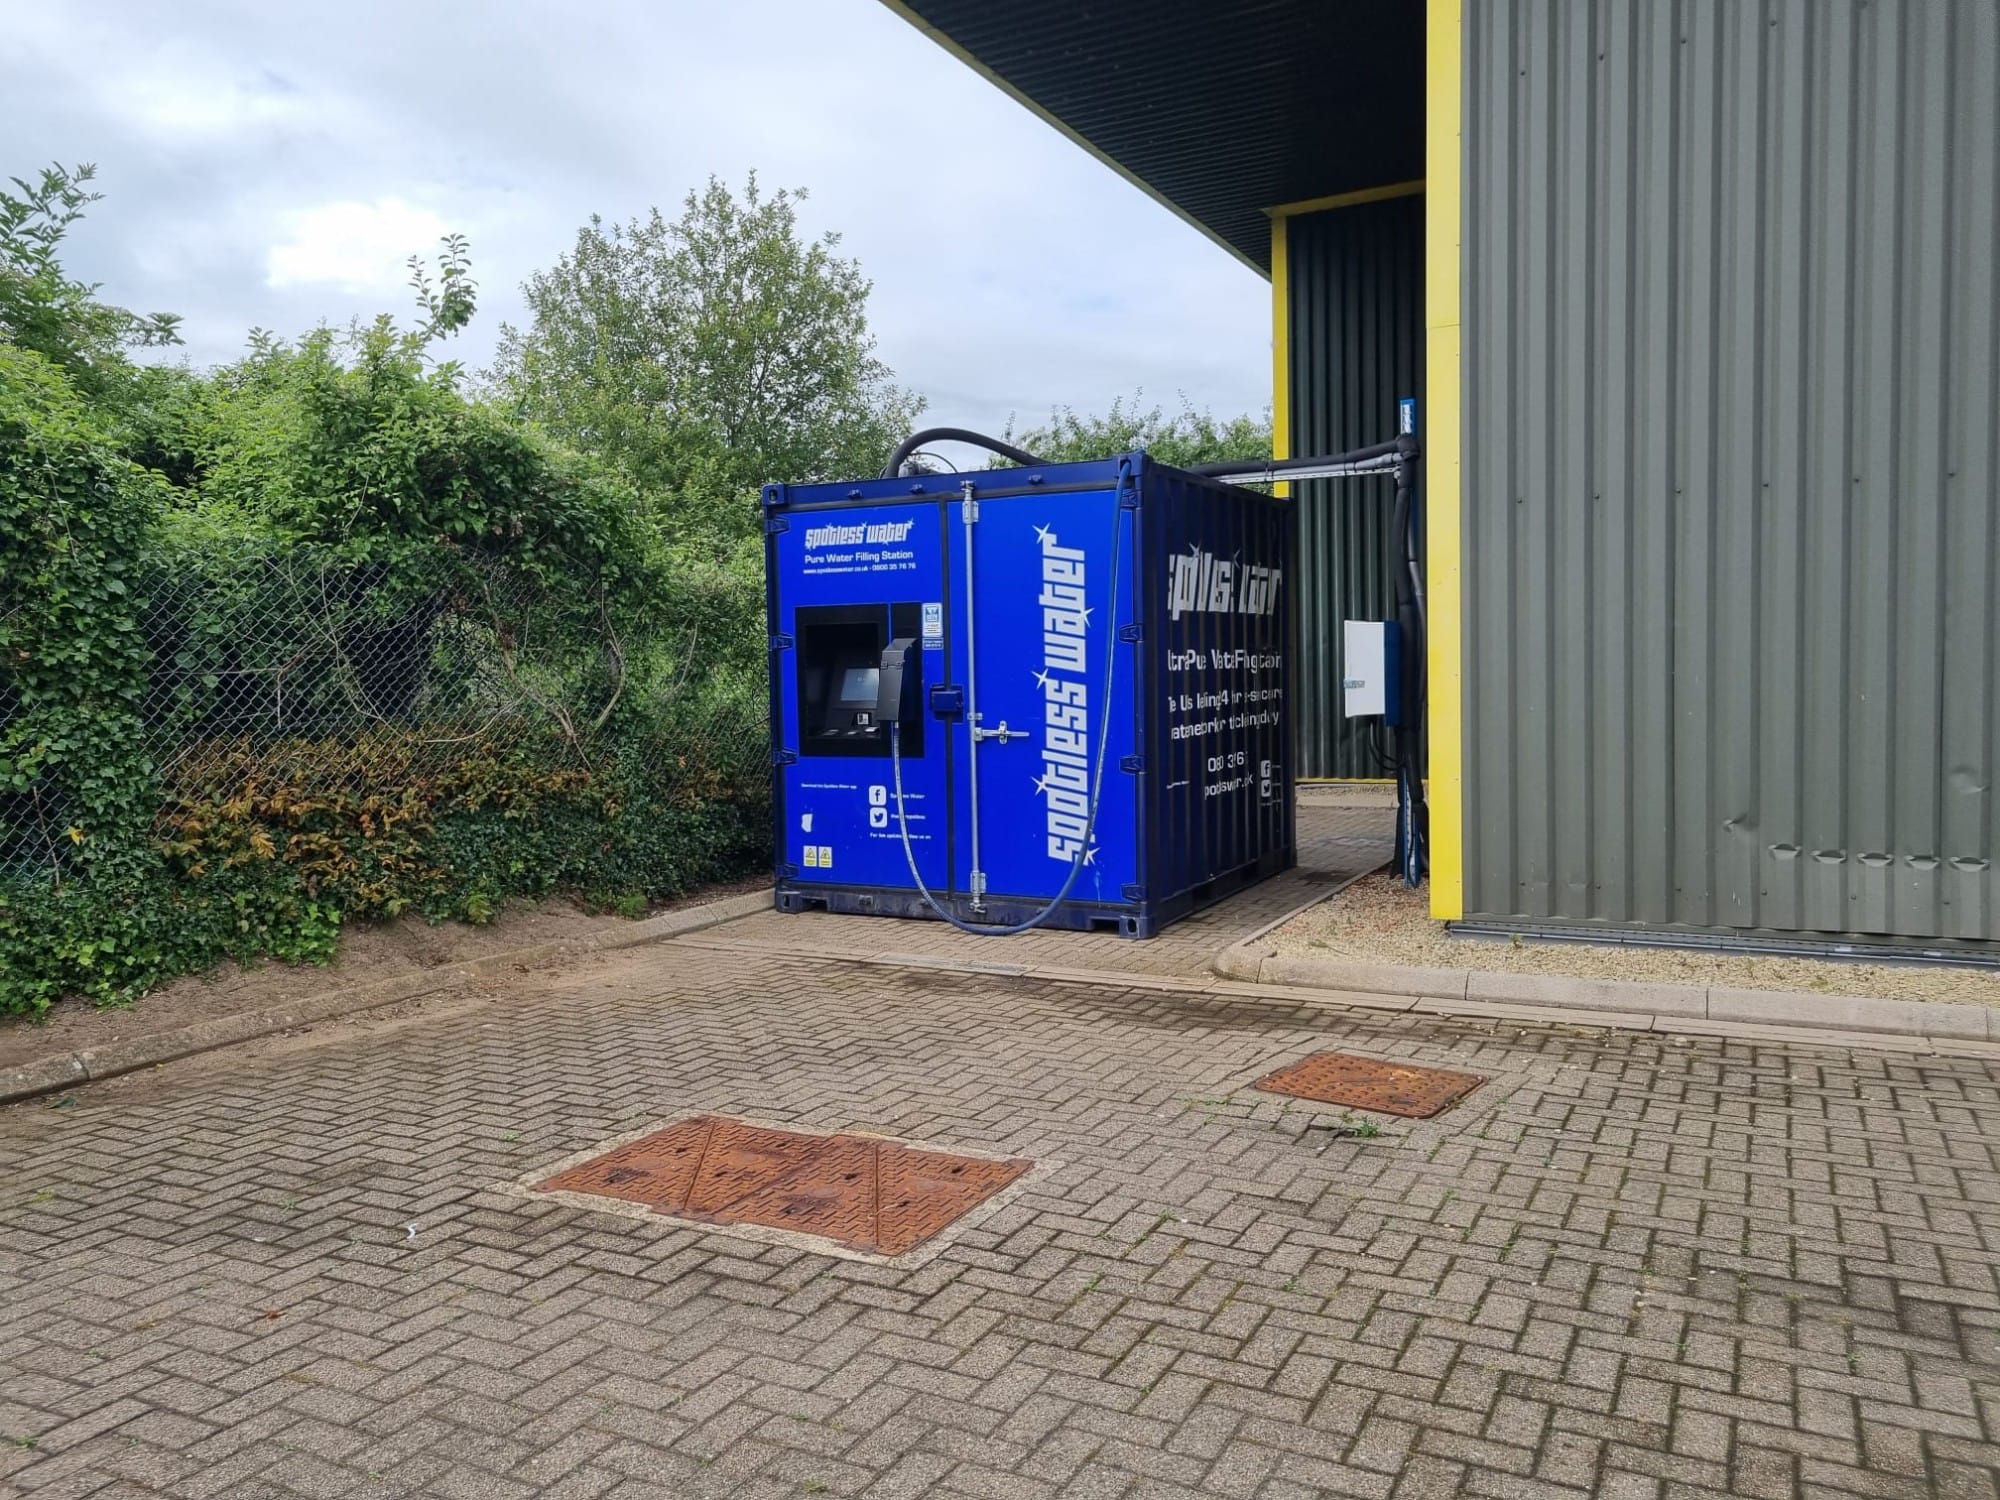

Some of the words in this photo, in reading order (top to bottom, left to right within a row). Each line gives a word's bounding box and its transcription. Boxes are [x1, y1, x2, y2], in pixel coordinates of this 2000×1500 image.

[805, 524, 865, 550] spotless
[865, 519, 913, 545] water
[804, 554, 825, 564] Pure
[826, 553, 854, 563] Water
[855, 551, 880, 563] Filling
[881, 550, 914, 560] Station
[1037, 531, 1088, 674] water
